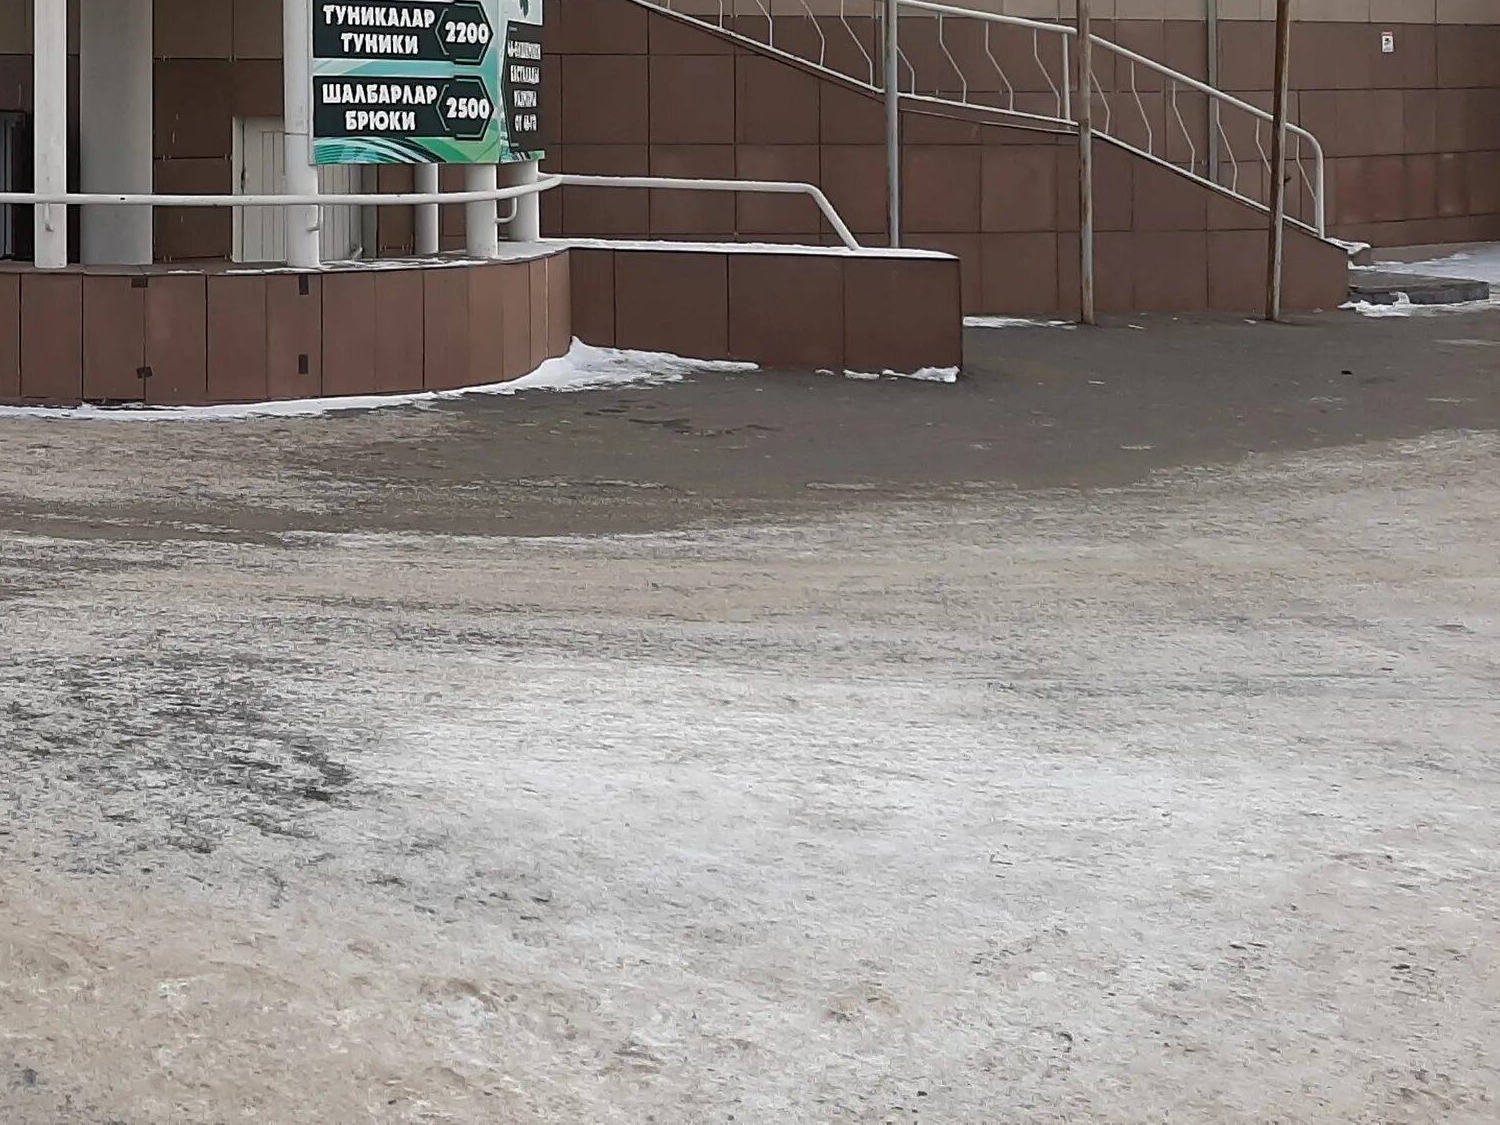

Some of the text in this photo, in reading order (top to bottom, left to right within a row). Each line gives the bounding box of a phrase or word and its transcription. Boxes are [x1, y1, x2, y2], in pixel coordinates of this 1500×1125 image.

[323, 4, 436, 28] ТУНИКАЛАР
[341, 32, 419, 55] ТУНИКИ
[445, 21, 490, 44] 2200
[322, 83, 438, 106] ШАЛБАРЛАР
[445, 97, 490, 120] 2500
[345, 110, 416, 132] БРЮКИ
